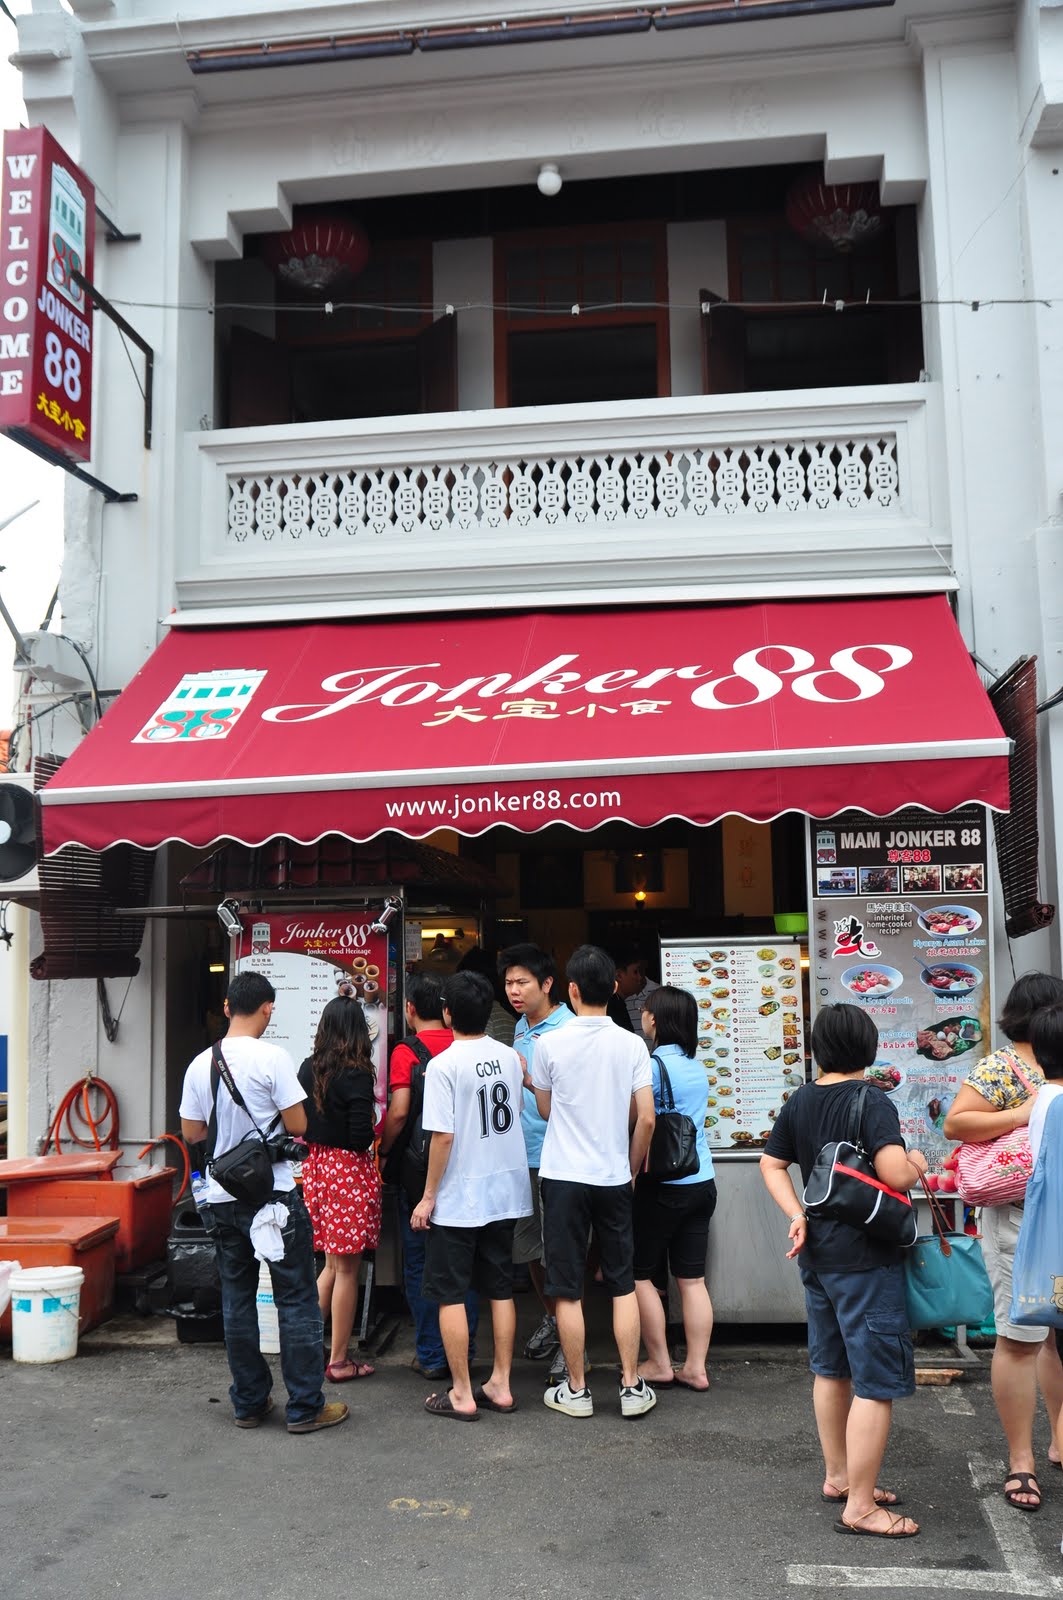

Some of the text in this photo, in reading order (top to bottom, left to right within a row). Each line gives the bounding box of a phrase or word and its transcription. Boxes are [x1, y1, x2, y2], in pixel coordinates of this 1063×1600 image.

[0, 154, 37, 396] WELCOME
[37, 283, 91, 353] JONKER
[44, 331, 82, 403] 88
[36, 391, 87, 442] 大宝小食
[261, 644, 913, 723] Jonker 88
[421, 698, 673, 728] 大宝小食
[385, 789, 622, 820] www.jonker88.com
[840, 829, 982, 849] MAM JONKER 88
[866, 920, 913, 928] home-cooked
[874, 913, 905, 921] inherited
[280, 921, 371, 948] Jonker 88
[879, 927, 901, 936] recipe
[345, 948, 371, 956] Heritage
[222, 1070, 235, 1093] DIGITAL
[476, 1060, 502, 1079] GOH
[476, 1080, 514, 1139] 18
[931, 1149, 947, 1158] pure
